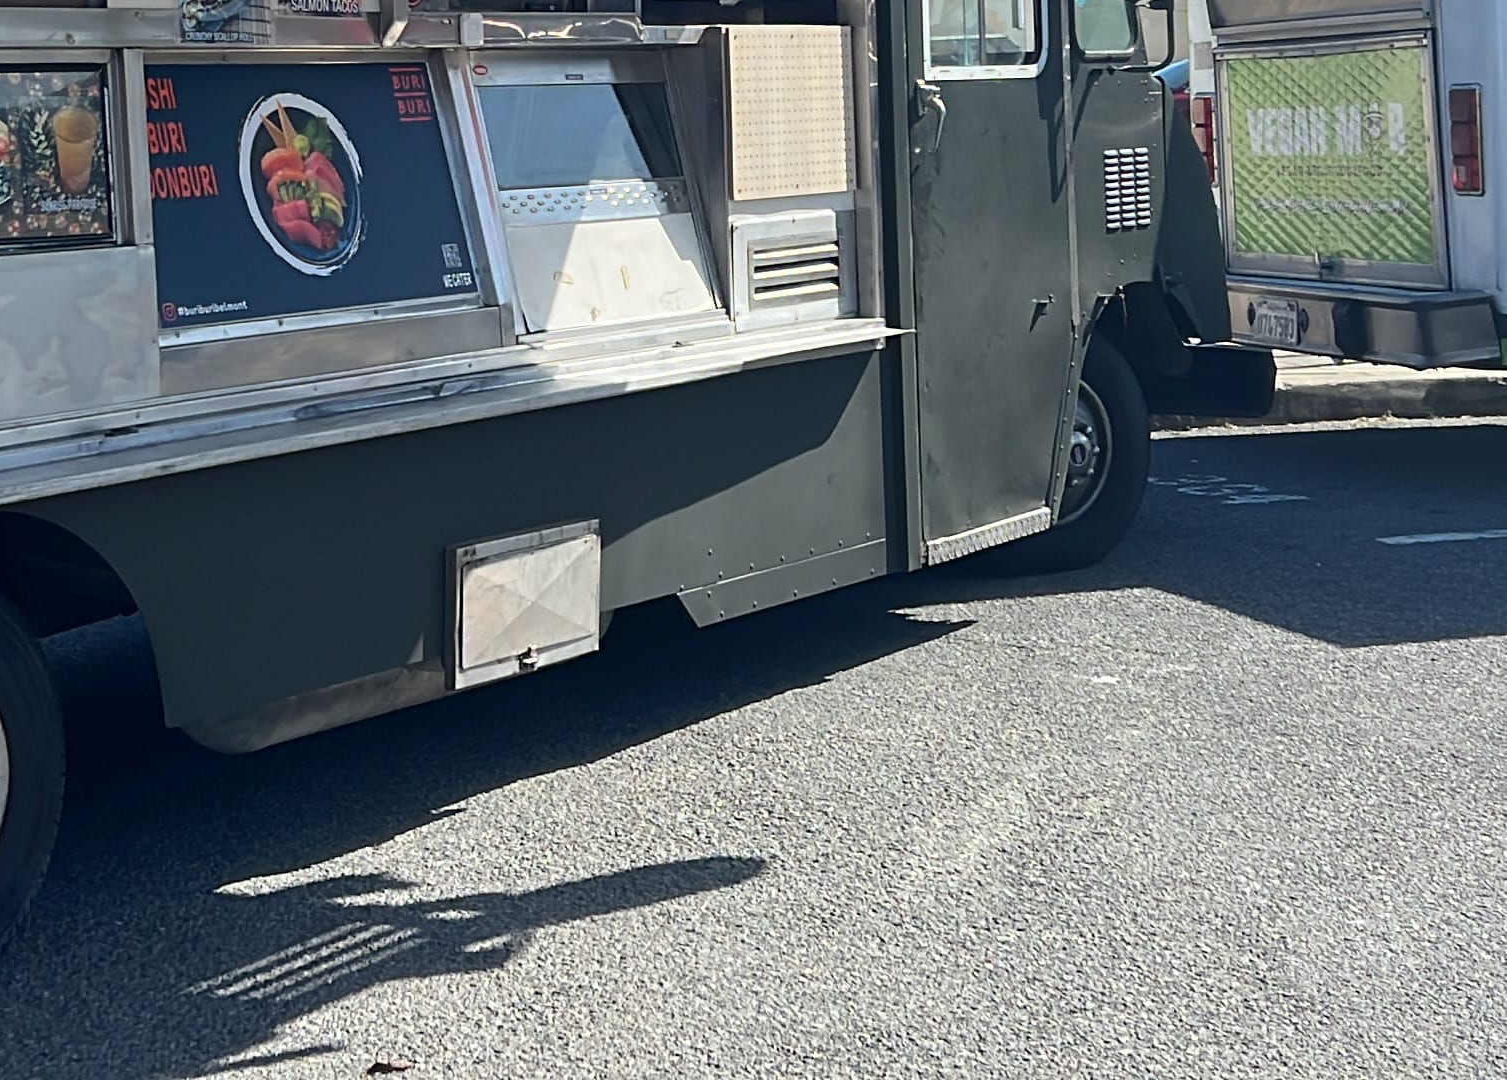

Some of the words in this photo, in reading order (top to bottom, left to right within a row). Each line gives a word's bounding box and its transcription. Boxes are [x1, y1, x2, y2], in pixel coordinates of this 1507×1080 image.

[331, 0, 359, 13] TACOS
[392, 74, 425, 89] BURI
[146, 78, 177, 110] SHI
[397, 99, 432, 115] BURI
[147, 122, 188, 154] BURI
[1246, 104, 1328, 157] VEGAN
